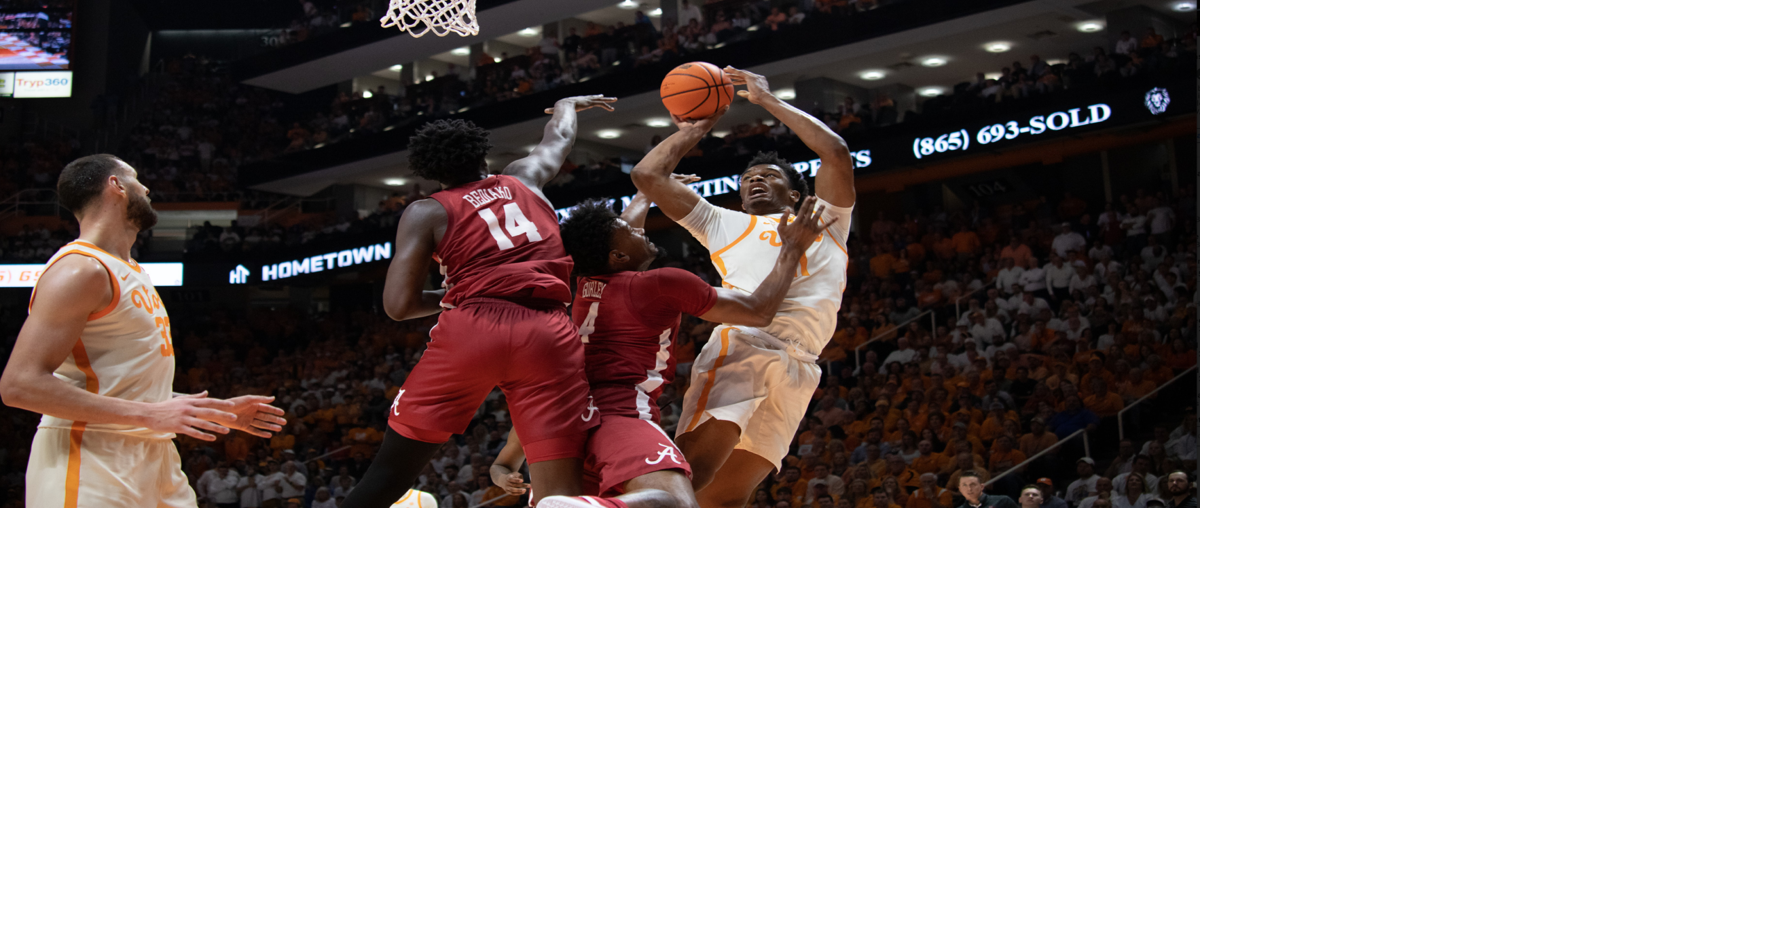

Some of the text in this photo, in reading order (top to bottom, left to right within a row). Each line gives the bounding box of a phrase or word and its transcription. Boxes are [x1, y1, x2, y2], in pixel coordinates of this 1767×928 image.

[17, 78, 69, 88] Tryp360
[913, 103, 1112, 159] (865) 693-SOLD
[462, 186, 513, 209] BEDIAKO
[477, 202, 543, 251] 14
[261, 242, 392, 281] HOMETOWN
[578, 301, 600, 343] 4
[645, 442, 682, 465] A
